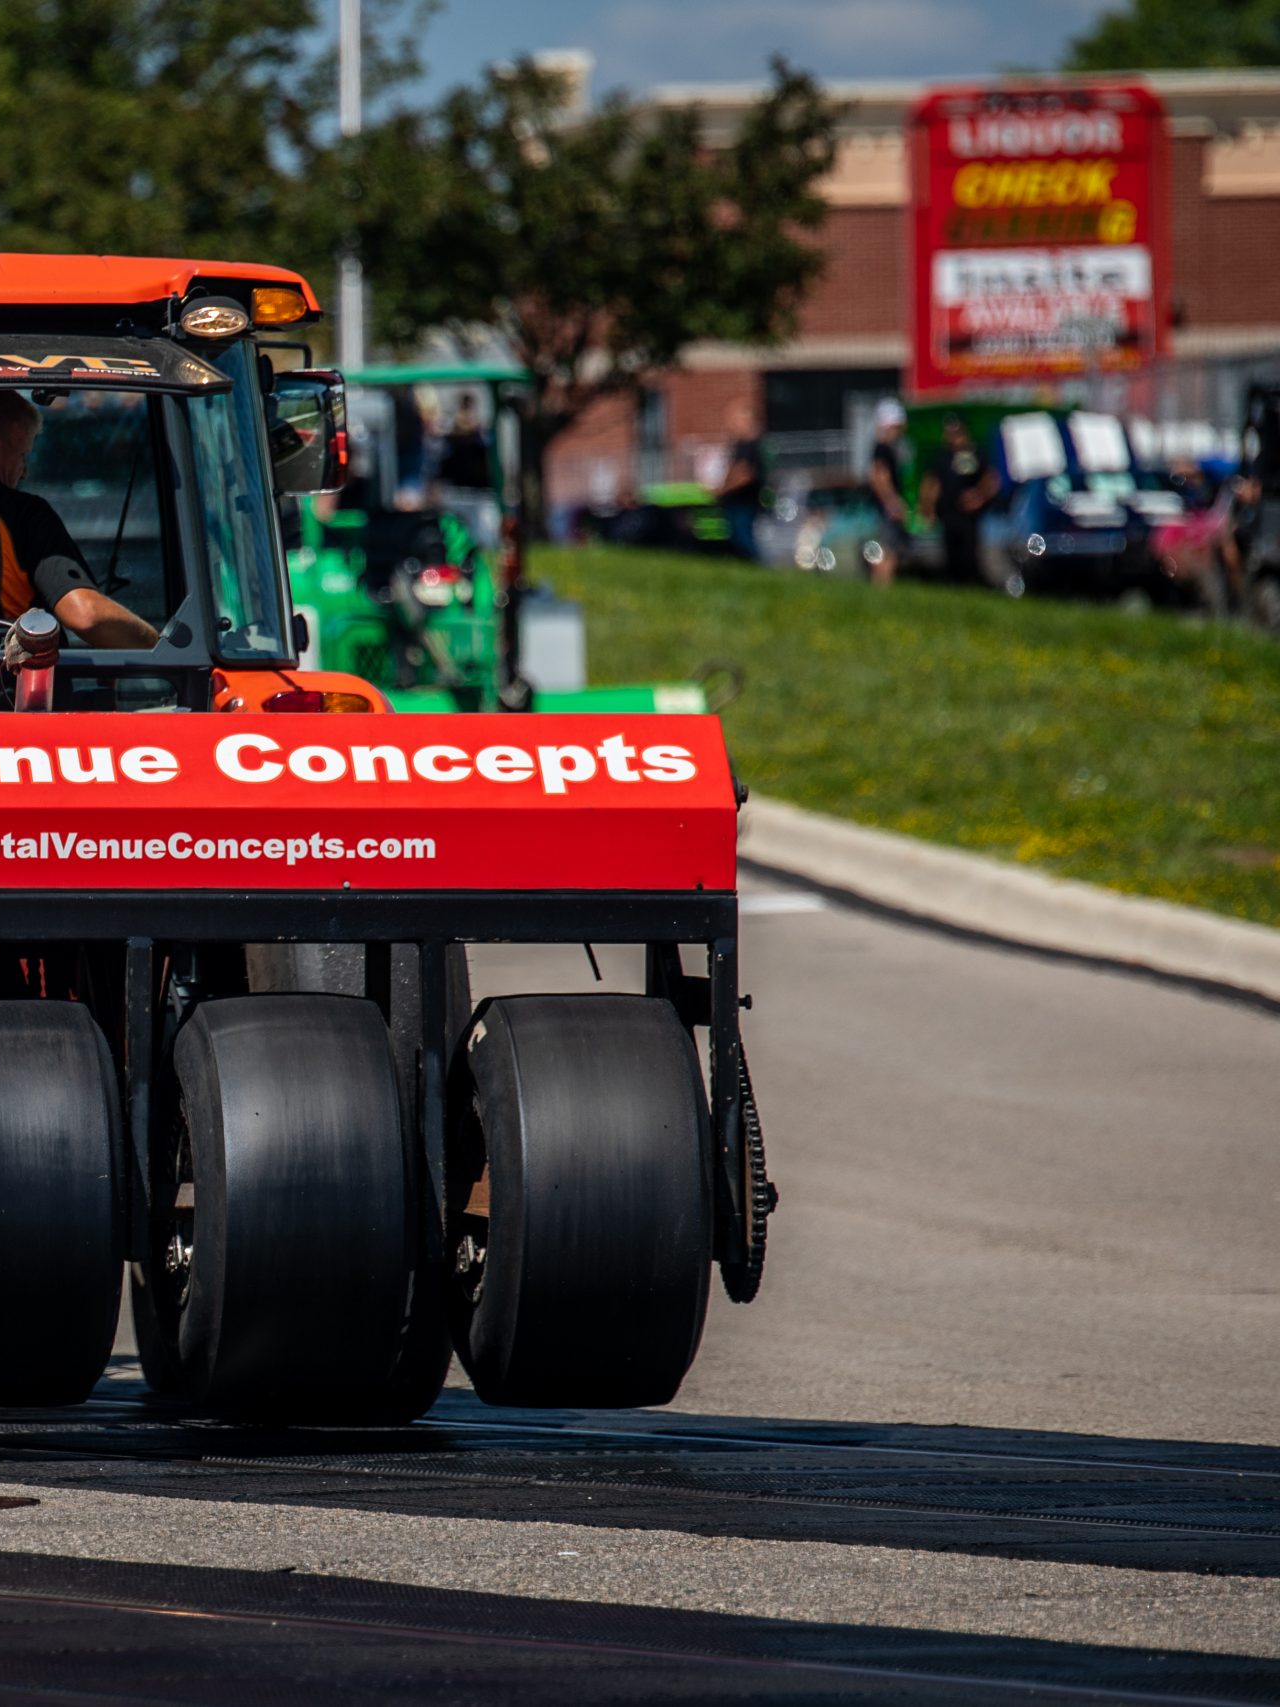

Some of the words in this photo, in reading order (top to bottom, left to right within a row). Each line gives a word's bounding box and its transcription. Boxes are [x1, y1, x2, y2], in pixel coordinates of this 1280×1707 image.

[948, 111, 1123, 156] LIQUOR
[953, 160, 1116, 207] CHECK
[215, 733, 697, 794] Concepts
